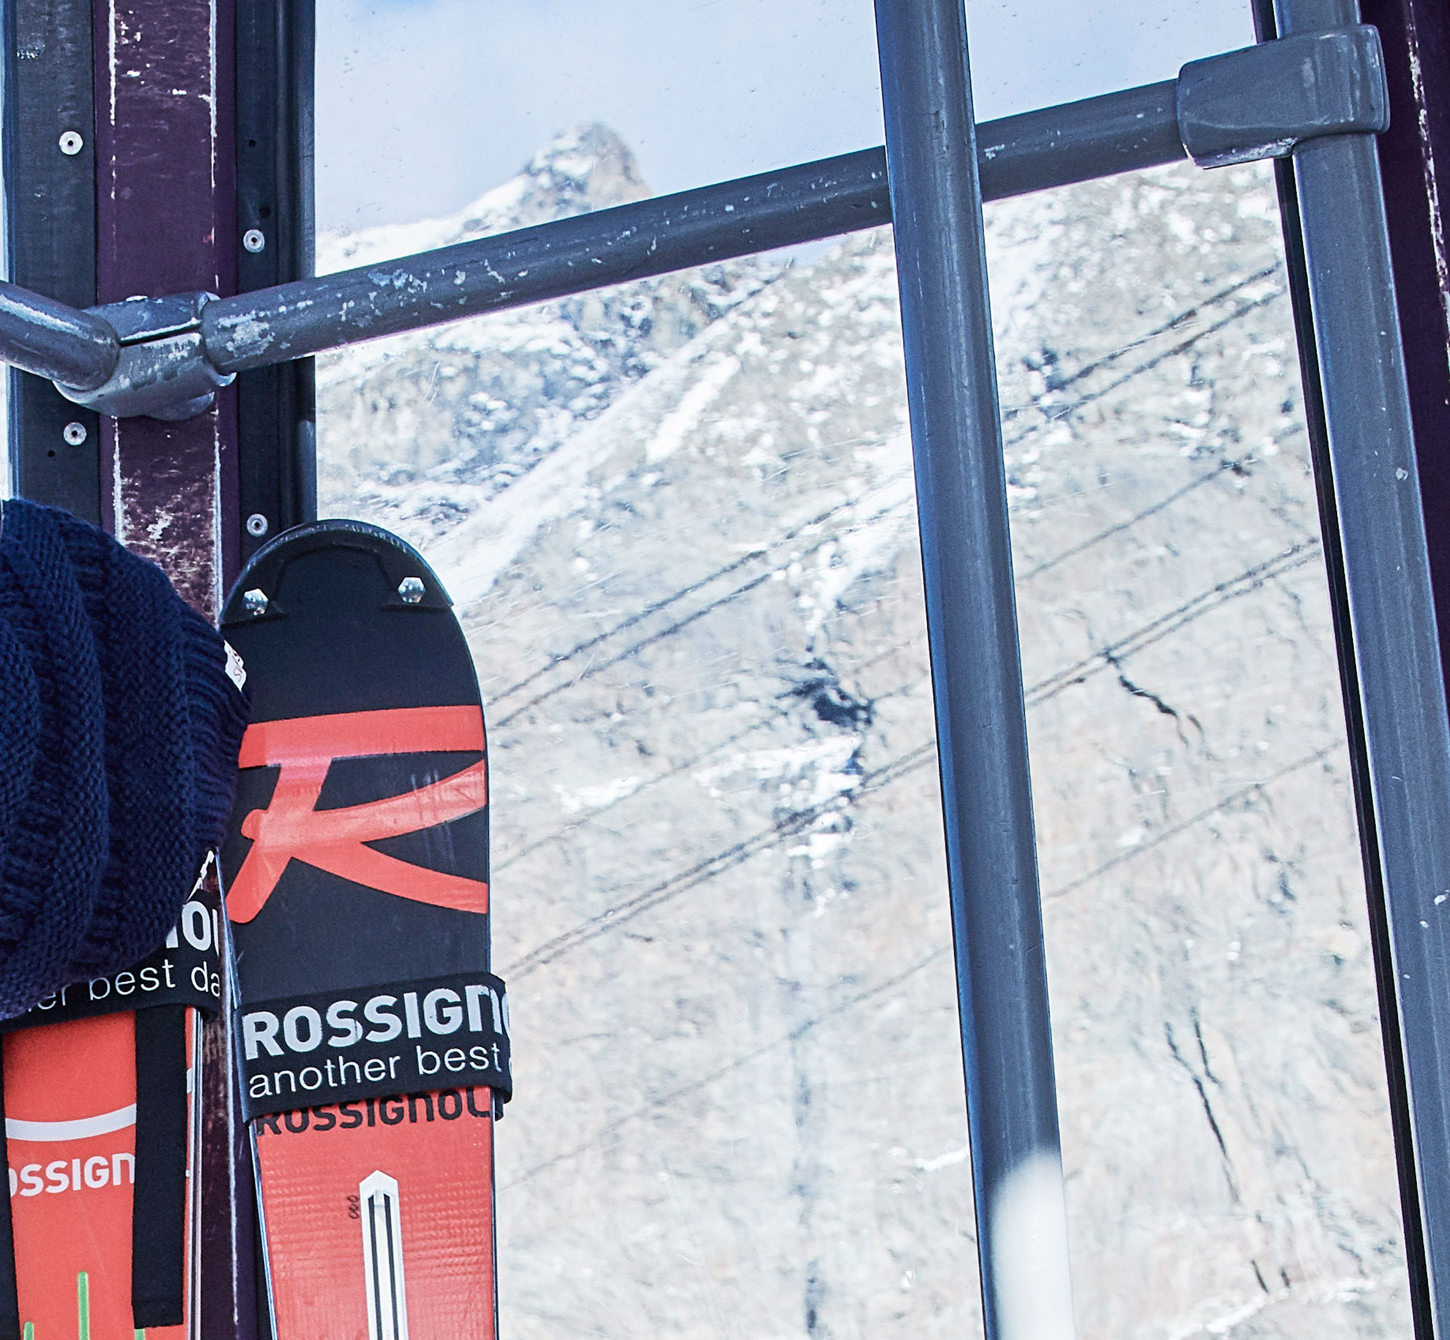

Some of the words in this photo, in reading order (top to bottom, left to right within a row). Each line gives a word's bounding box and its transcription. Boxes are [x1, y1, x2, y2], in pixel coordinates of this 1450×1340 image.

[242, 984, 509, 1061] ROSSIGN
[249, 1055, 402, 1098] another
[416, 1043, 502, 1075] best
